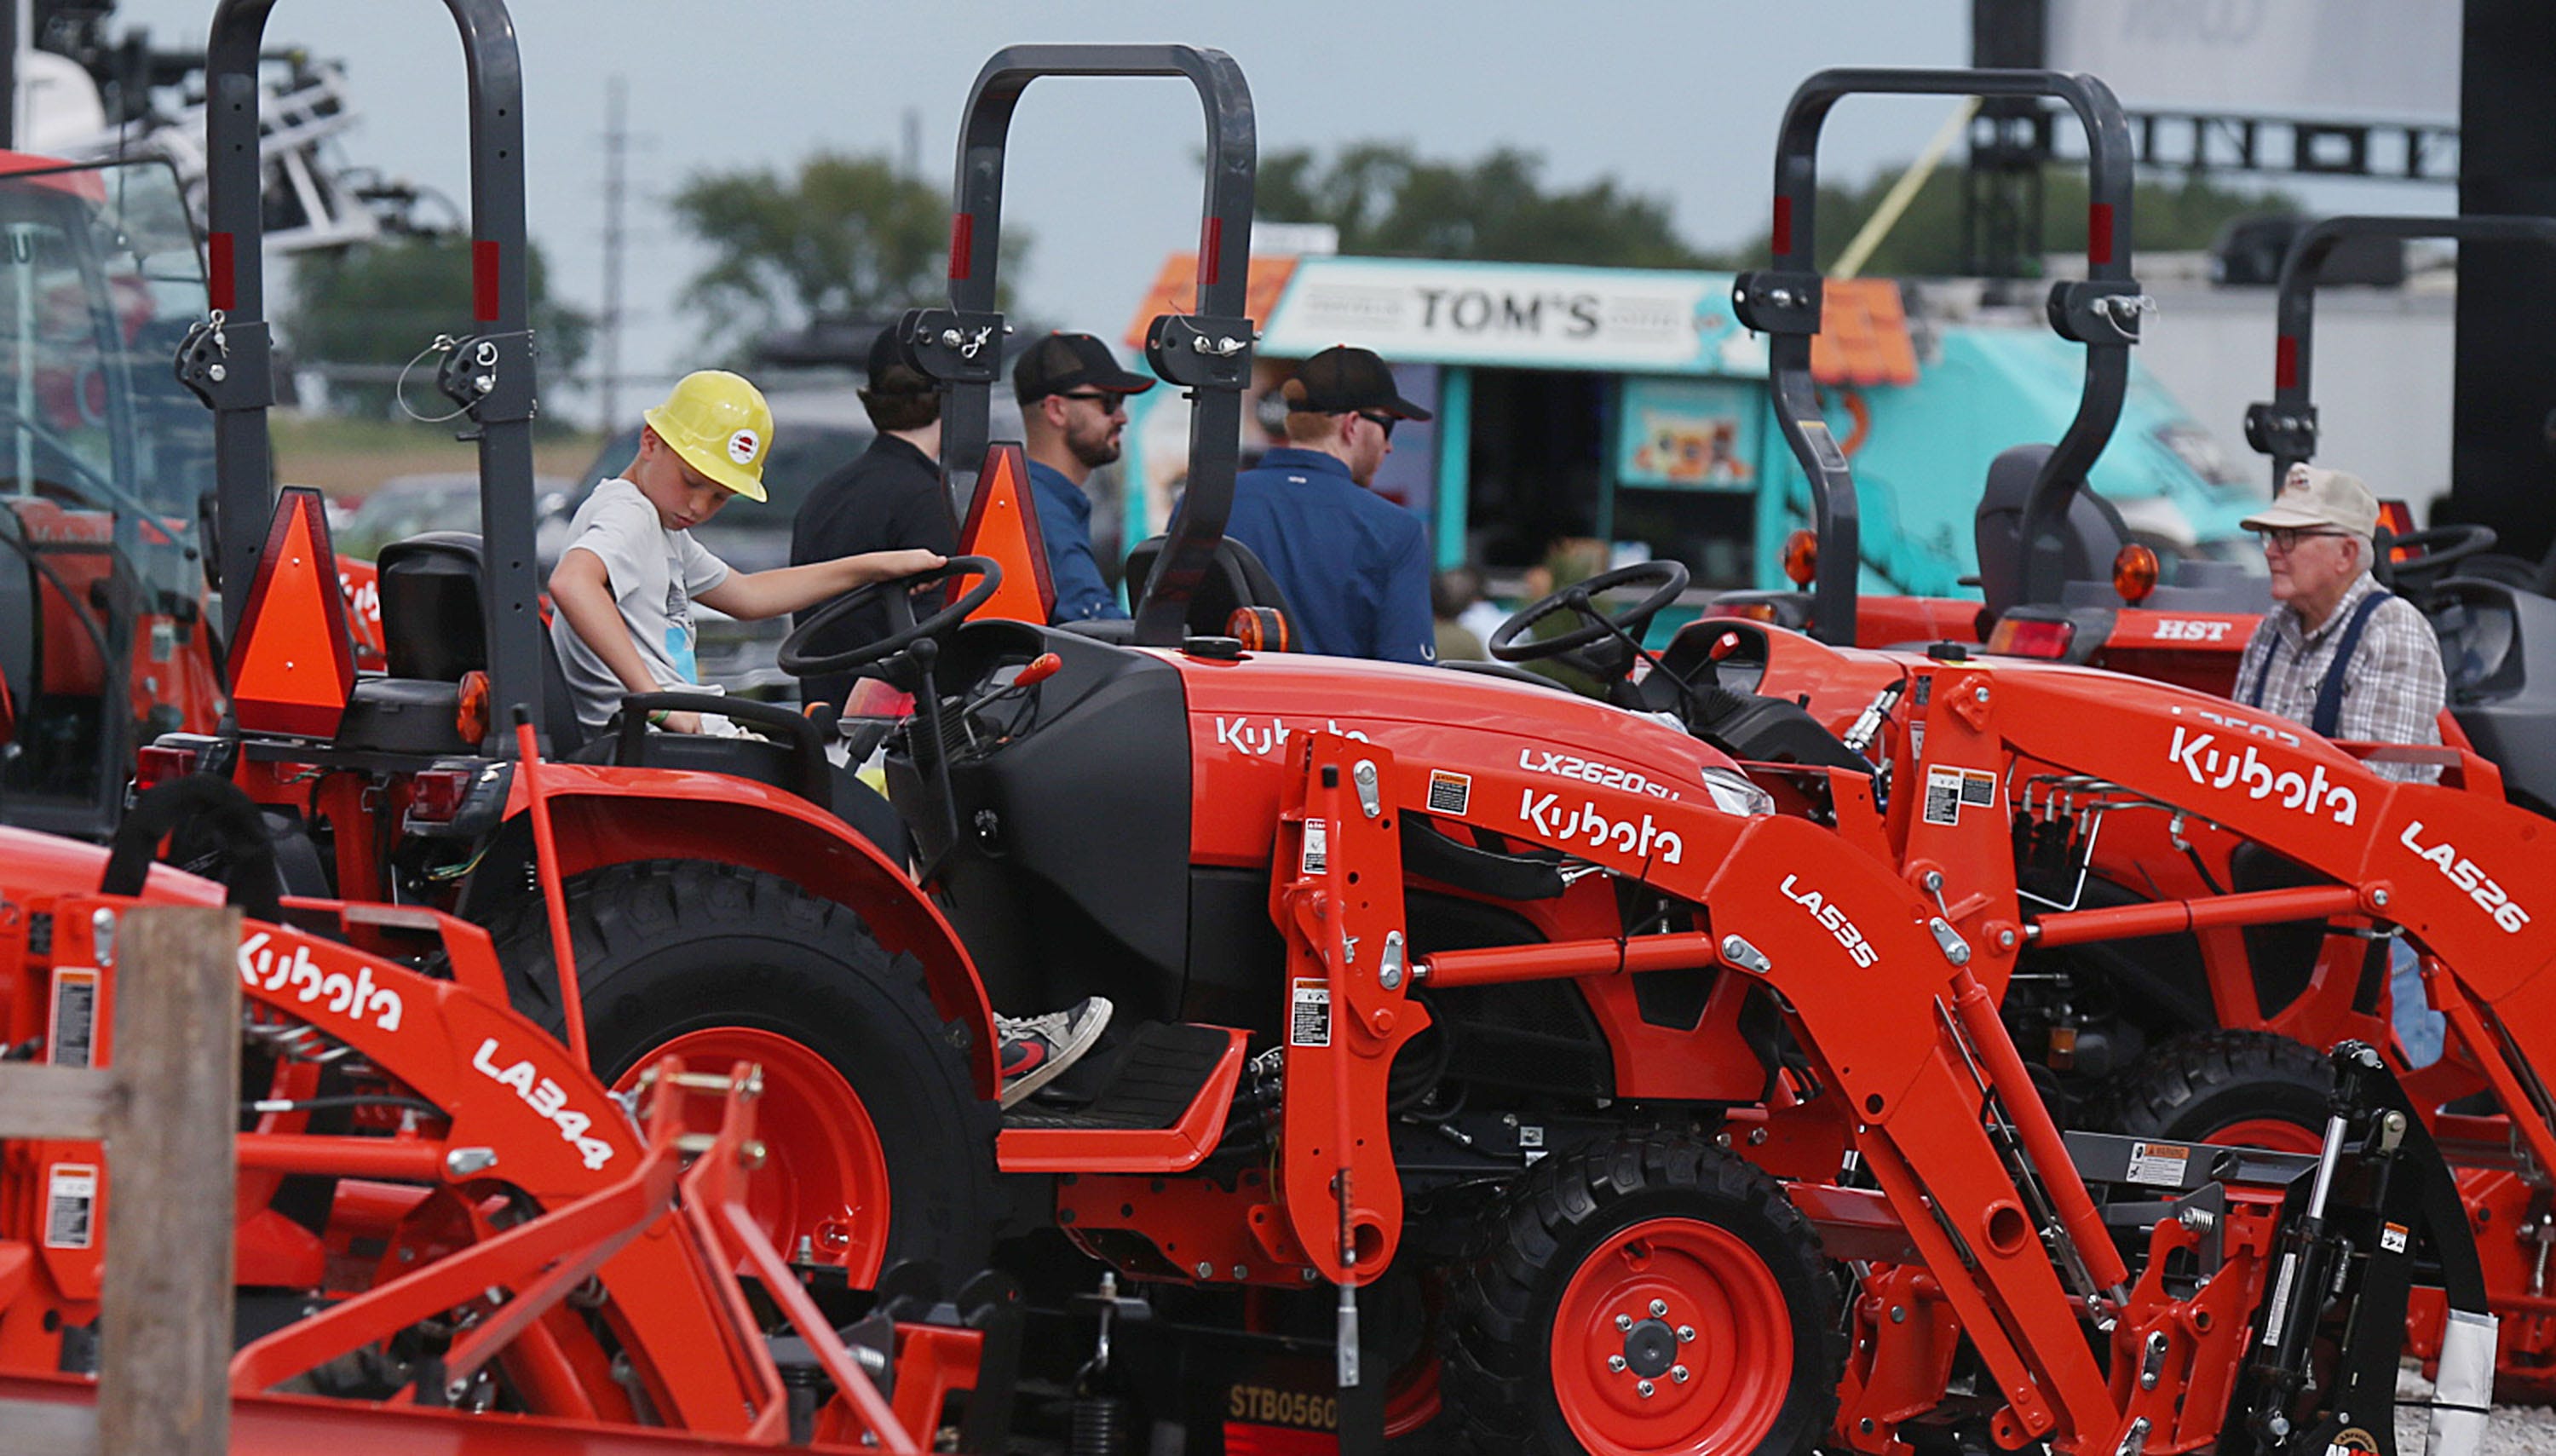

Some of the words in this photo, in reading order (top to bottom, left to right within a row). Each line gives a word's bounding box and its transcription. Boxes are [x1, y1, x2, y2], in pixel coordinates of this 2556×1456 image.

[1416, 290, 1599, 338] TOM'S
[2153, 619, 2232, 642] HST
[2169, 726, 2357, 826] Kubota
[1520, 788, 1682, 864] Kubota
[1780, 874, 1879, 969] LA535
[2400, 820, 2530, 934] LA526
[472, 1038, 613, 1170] LA344
